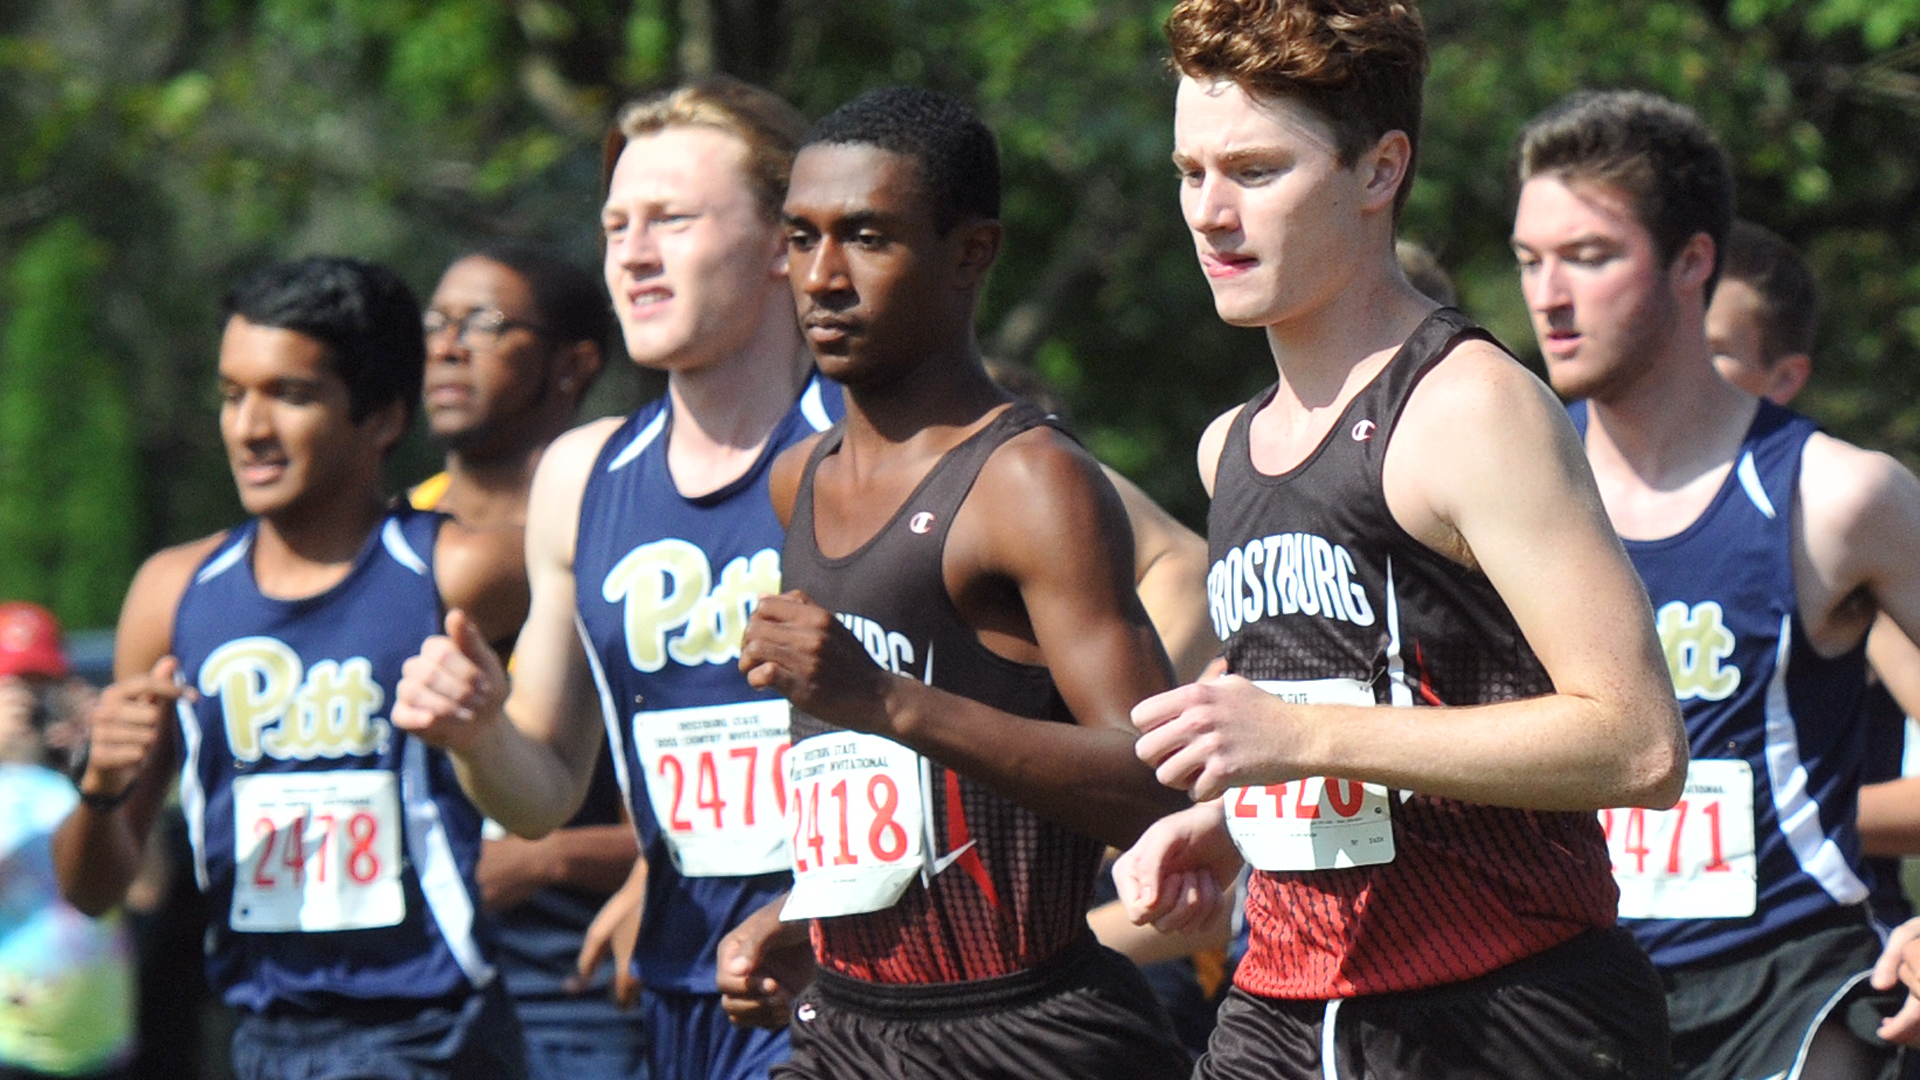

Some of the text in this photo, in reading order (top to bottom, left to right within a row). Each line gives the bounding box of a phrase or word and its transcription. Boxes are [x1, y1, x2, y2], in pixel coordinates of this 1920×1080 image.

[198, 635, 391, 762] Pitt
[254, 813, 379, 885] 2478
[792, 773, 908, 873] 2418
